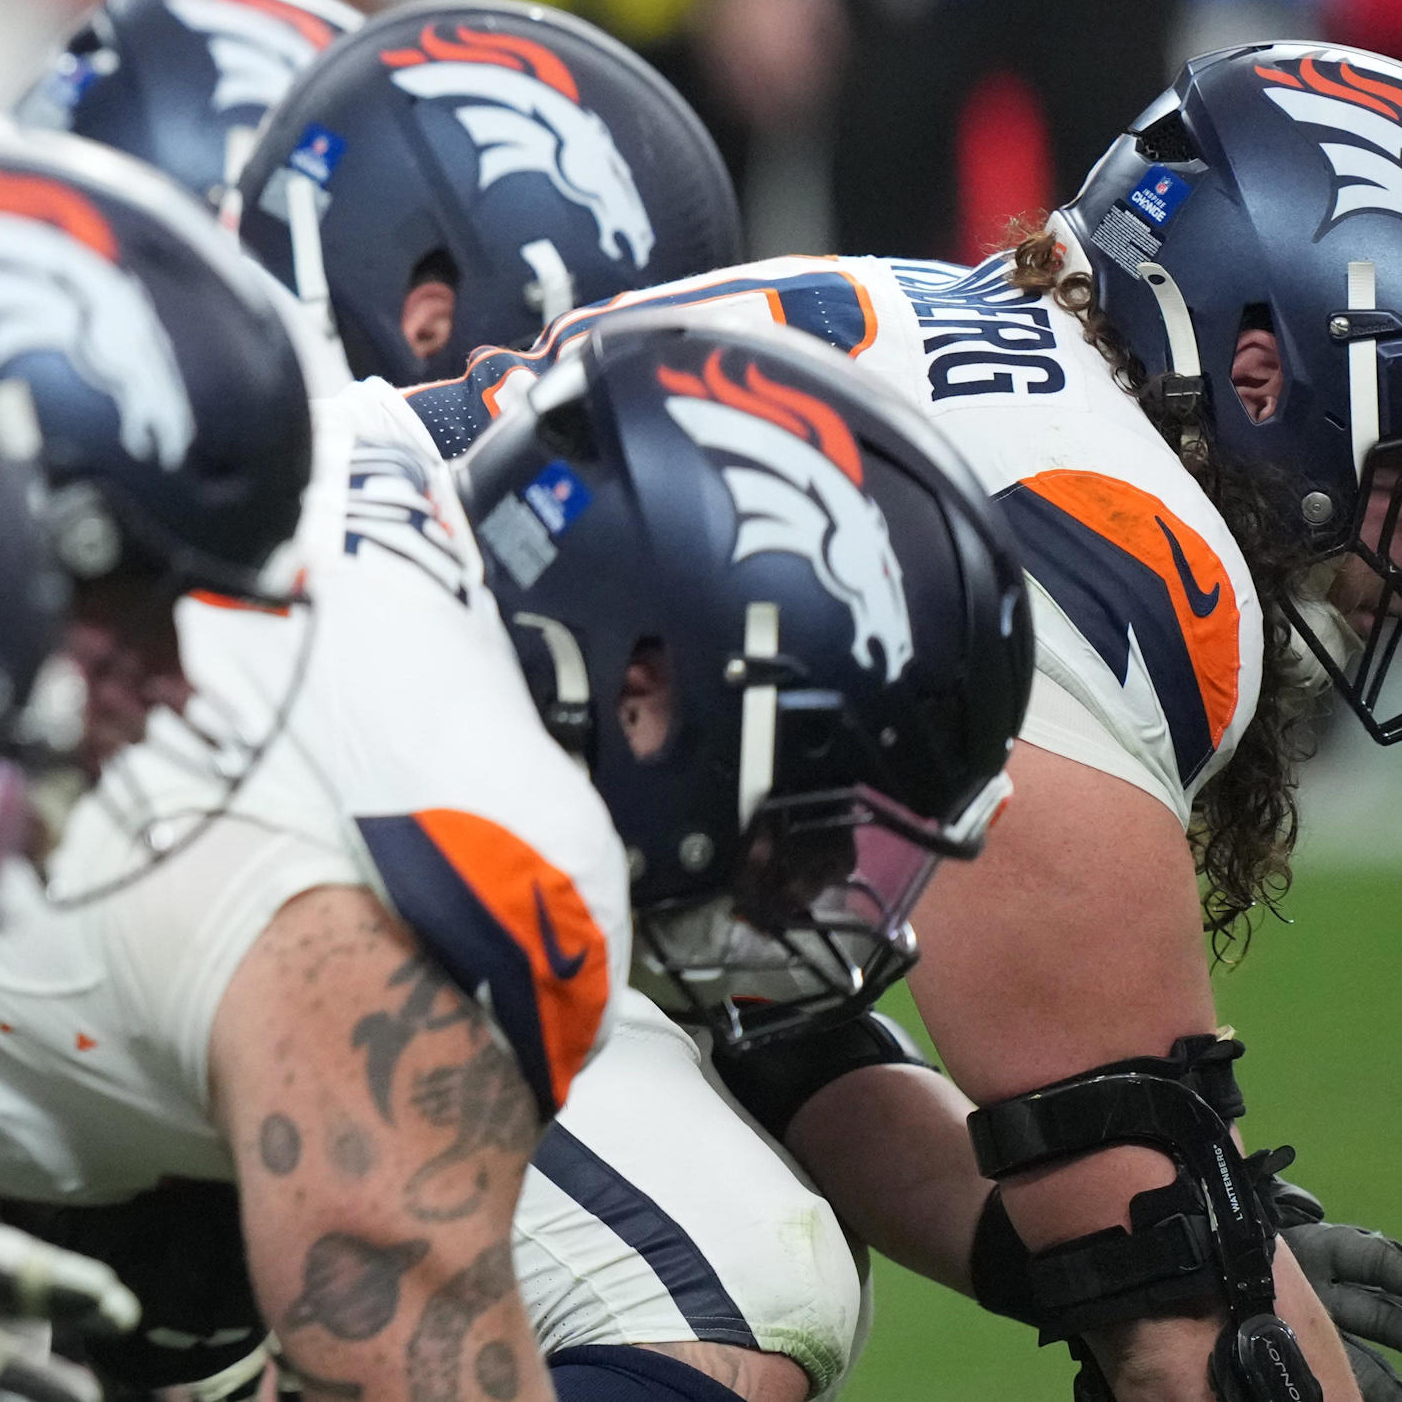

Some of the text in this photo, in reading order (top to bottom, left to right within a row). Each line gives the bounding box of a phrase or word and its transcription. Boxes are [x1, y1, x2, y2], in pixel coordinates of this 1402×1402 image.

[1131, 190, 1167, 222] CHANGE
[1214, 1146, 1240, 1213] WATTENBERG
[1262, 1337, 1301, 1402] ONJOY
